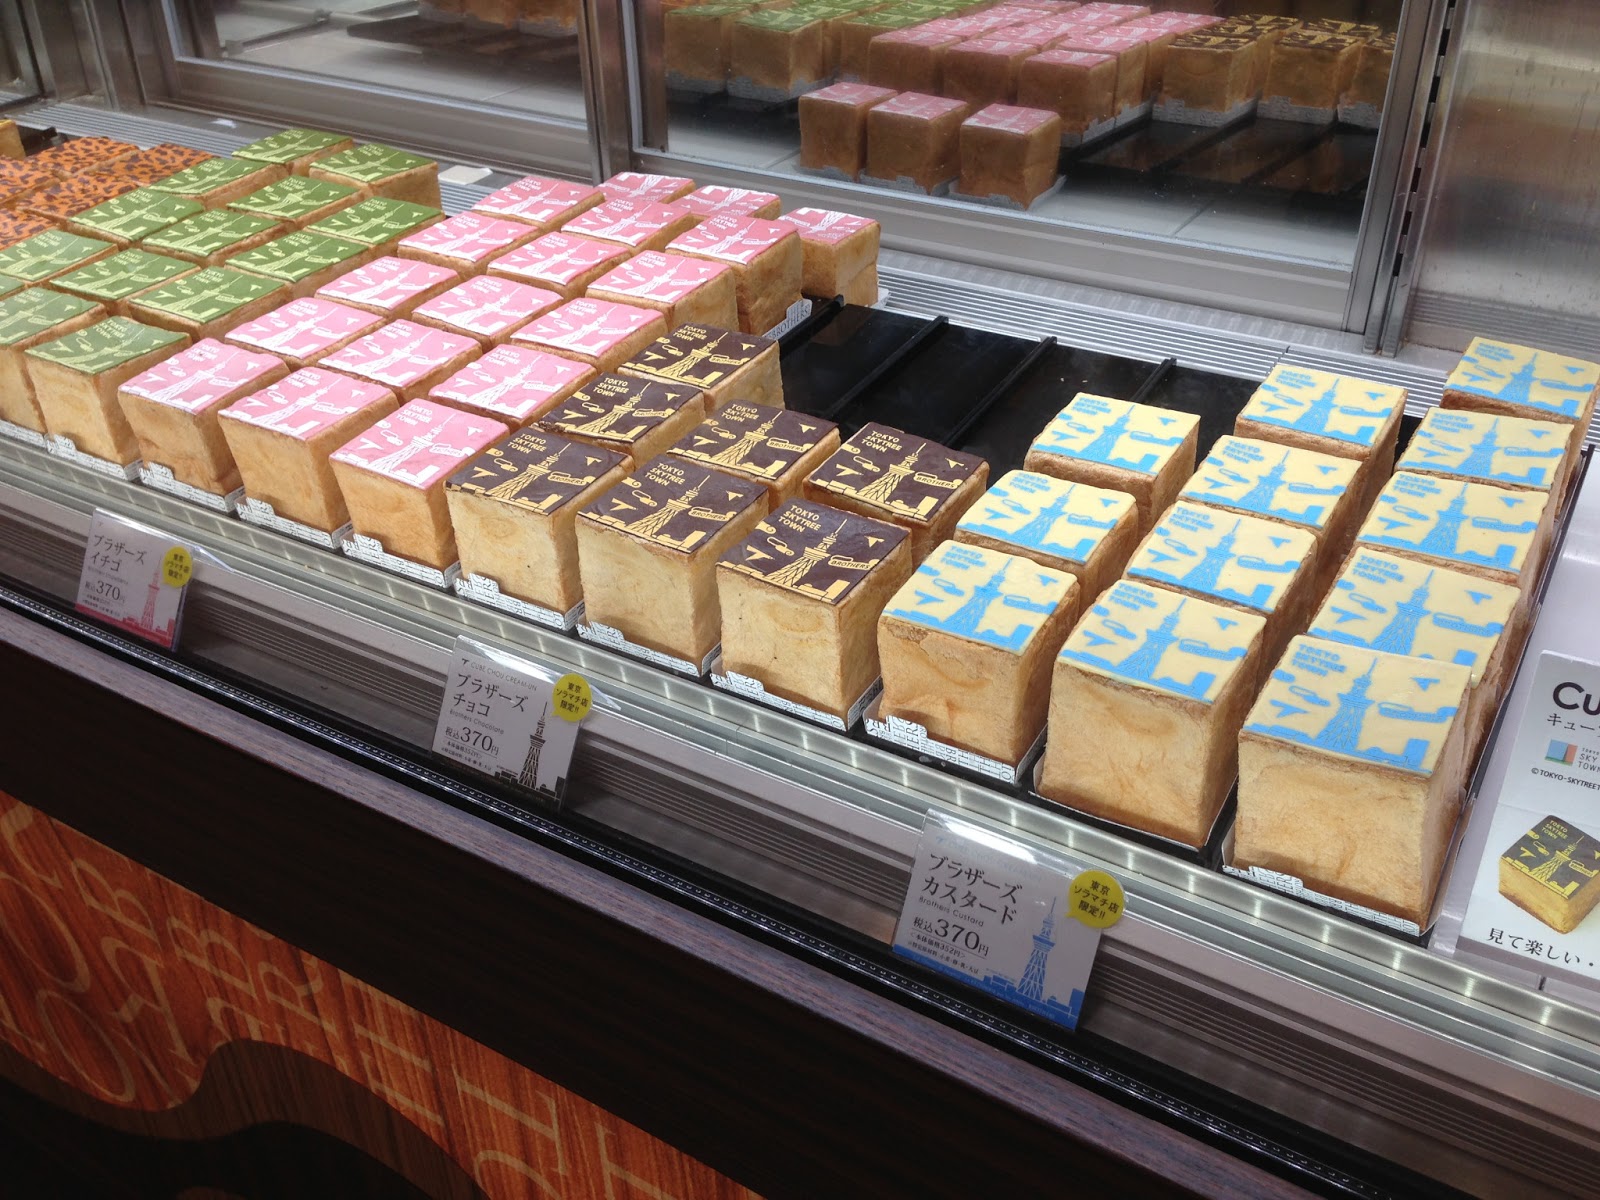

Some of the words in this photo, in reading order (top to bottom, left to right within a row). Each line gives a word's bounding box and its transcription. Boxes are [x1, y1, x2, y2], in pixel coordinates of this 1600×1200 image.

[599, 383, 630, 394] SKYTREE
[605, 378, 628, 387] TOKYO
[593, 387, 615, 397] TOWN
[725, 409, 760, 420] SKYTREE
[732, 404, 758, 414] TOKYO
[721, 413, 744, 423] TOWN
[520, 433, 547, 445] TOKYO
[866, 436, 903, 450] SKYTREE
[872, 431, 900, 443] TOKYO
[508, 442, 532, 454] TOWN
[513, 439, 548, 451] SKYTREE
[862, 440, 888, 452] TOWN
[650, 468, 686, 484] SKYTREE
[659, 463, 685, 476] TOKYO
[645, 473, 669, 486] TOWN
[790, 505, 820, 520] TOKYO
[779, 516, 806, 532] TOWN
[783, 511, 822, 530] SKYTREE
[94, 535, 147, 565] ブラザーズ
[91, 552, 122, 572] イチゴ
[457, 673, 529, 712] ブラザーズ
[567, 682, 581, 693] 東京
[556, 688, 589, 707] ソラマチ店
[453, 693, 490, 717] チョコ
[1547, 713, 1600, 738] キュー
[929, 854, 1023, 904] ブラザーズ
[1091, 880, 1111, 896] 東京
[922, 876, 1017, 924] カスタード
[1074, 885, 1119, 914] ソラマチ店
[919, 897, 950, 913] Brothers
[952, 909, 984, 927] Custard
